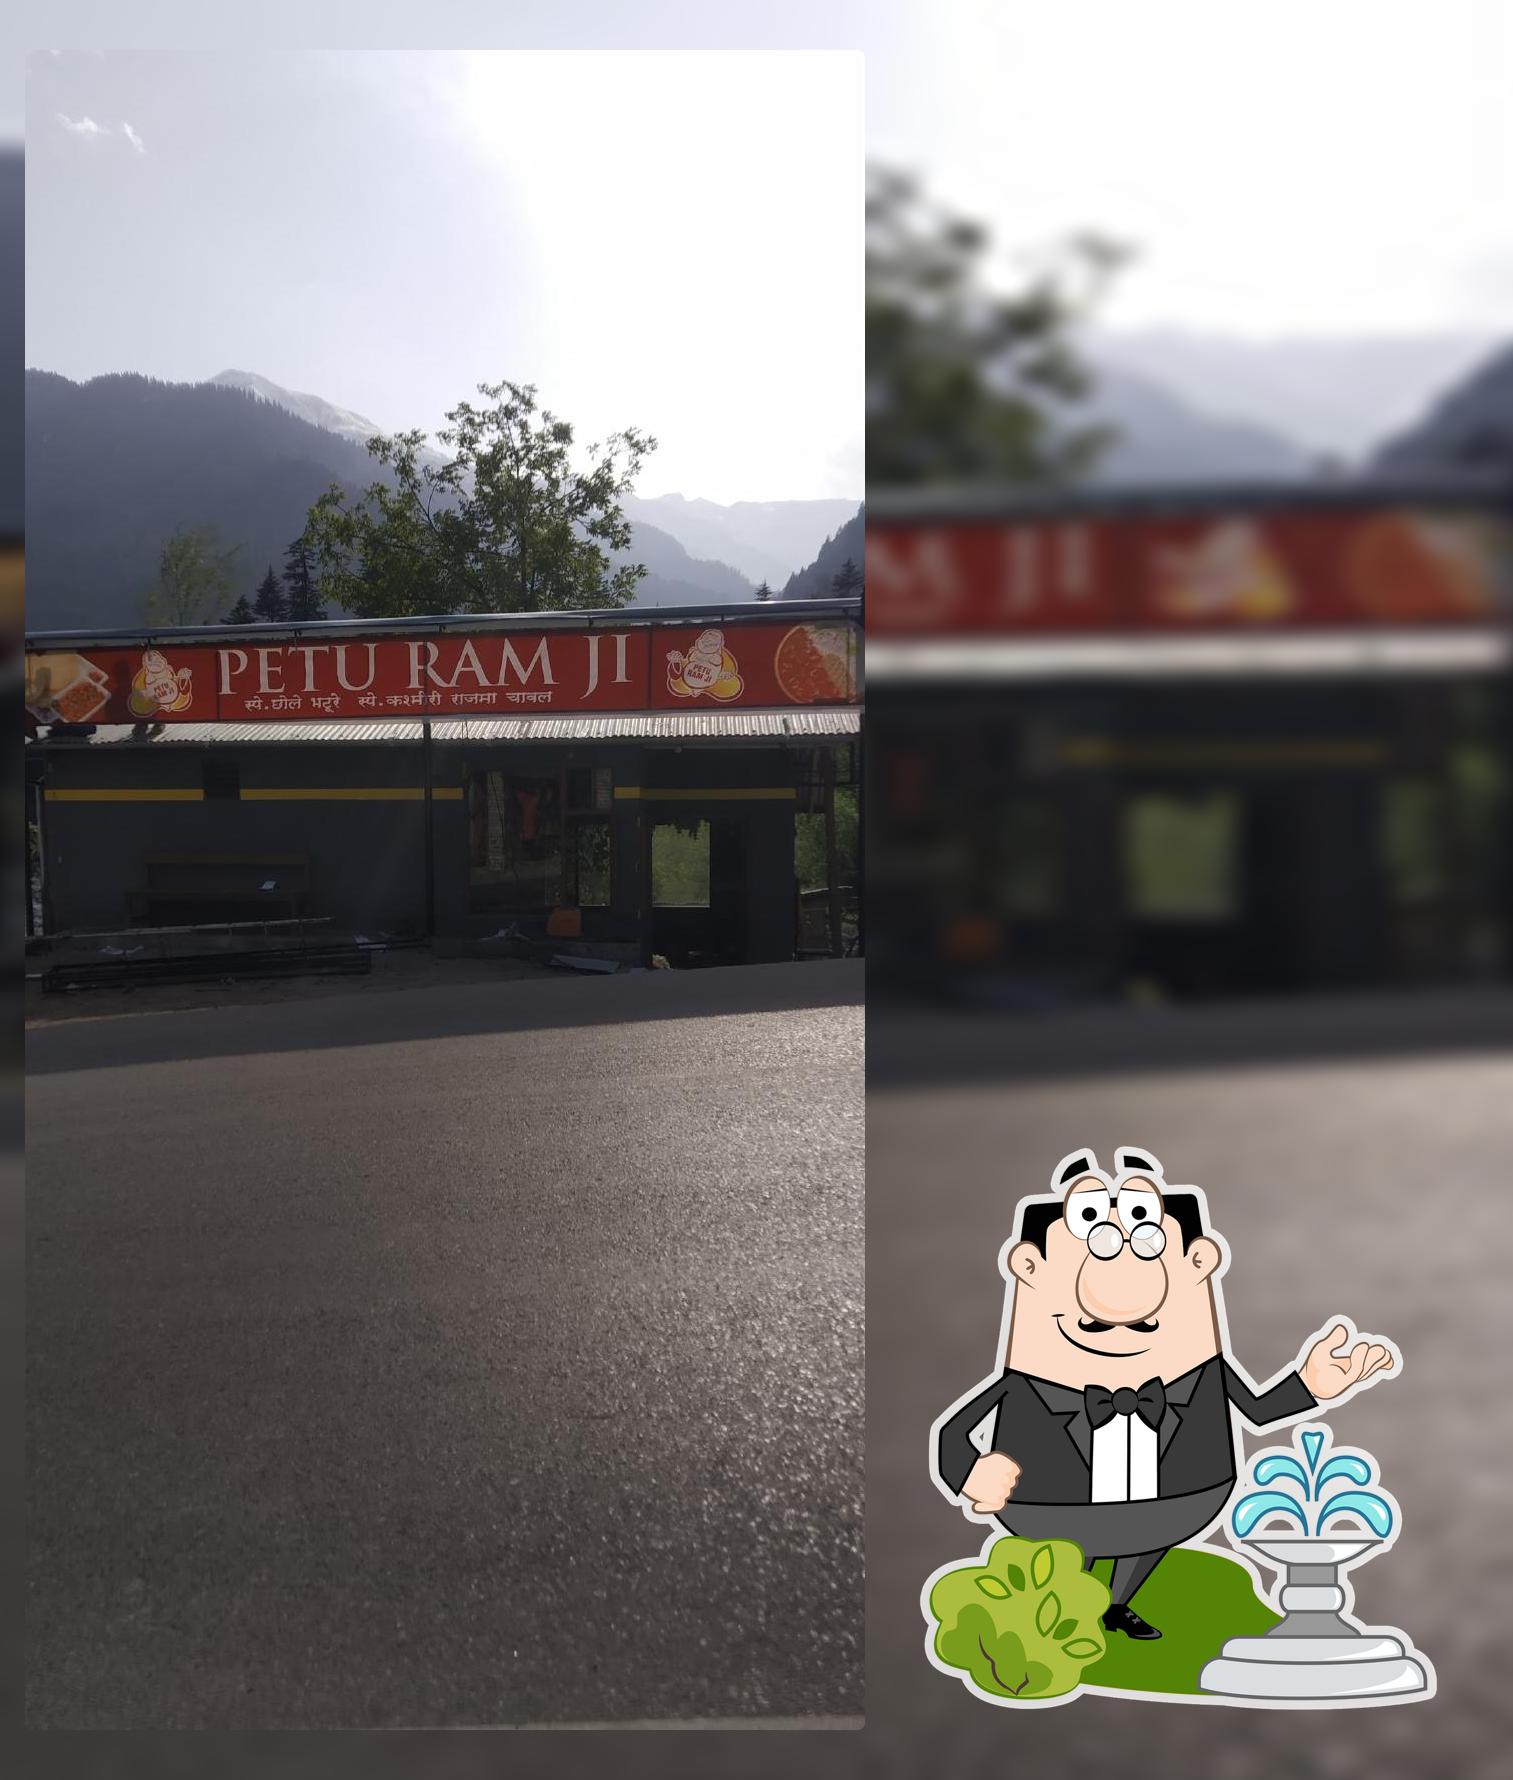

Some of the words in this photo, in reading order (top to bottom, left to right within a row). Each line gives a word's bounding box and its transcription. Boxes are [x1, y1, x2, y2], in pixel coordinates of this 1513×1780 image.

[217, 643, 379, 695] PETU
[405, 635, 560, 689] RAM
[579, 634, 632, 700] JI
[687, 669, 704, 680] RAM
[693, 663, 712, 675] PETU
[311, 692, 342, 713] भटूरे
[450, 692, 498, 705] राजमा
[506, 690, 553, 704] चावल
